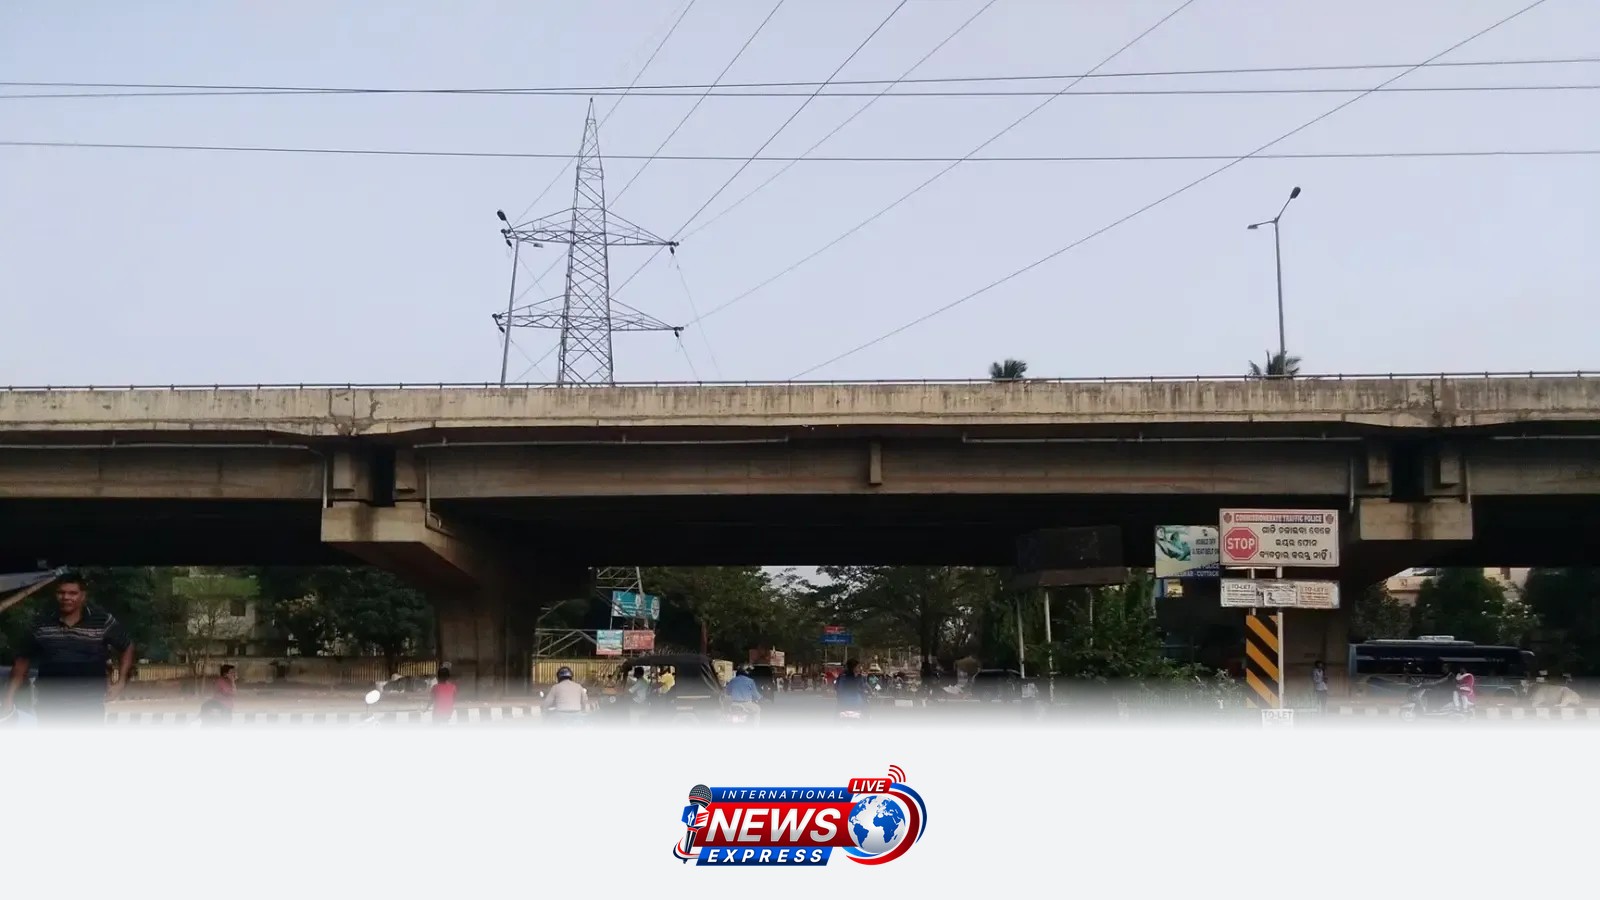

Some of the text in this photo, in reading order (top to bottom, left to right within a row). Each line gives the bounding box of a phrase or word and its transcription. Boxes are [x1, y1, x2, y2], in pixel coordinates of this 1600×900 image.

[1283, 515, 1304, 523] TRAFFIC
[1304, 515, 1322, 523] POLICE
[1227, 537, 1255, 550] STOP
